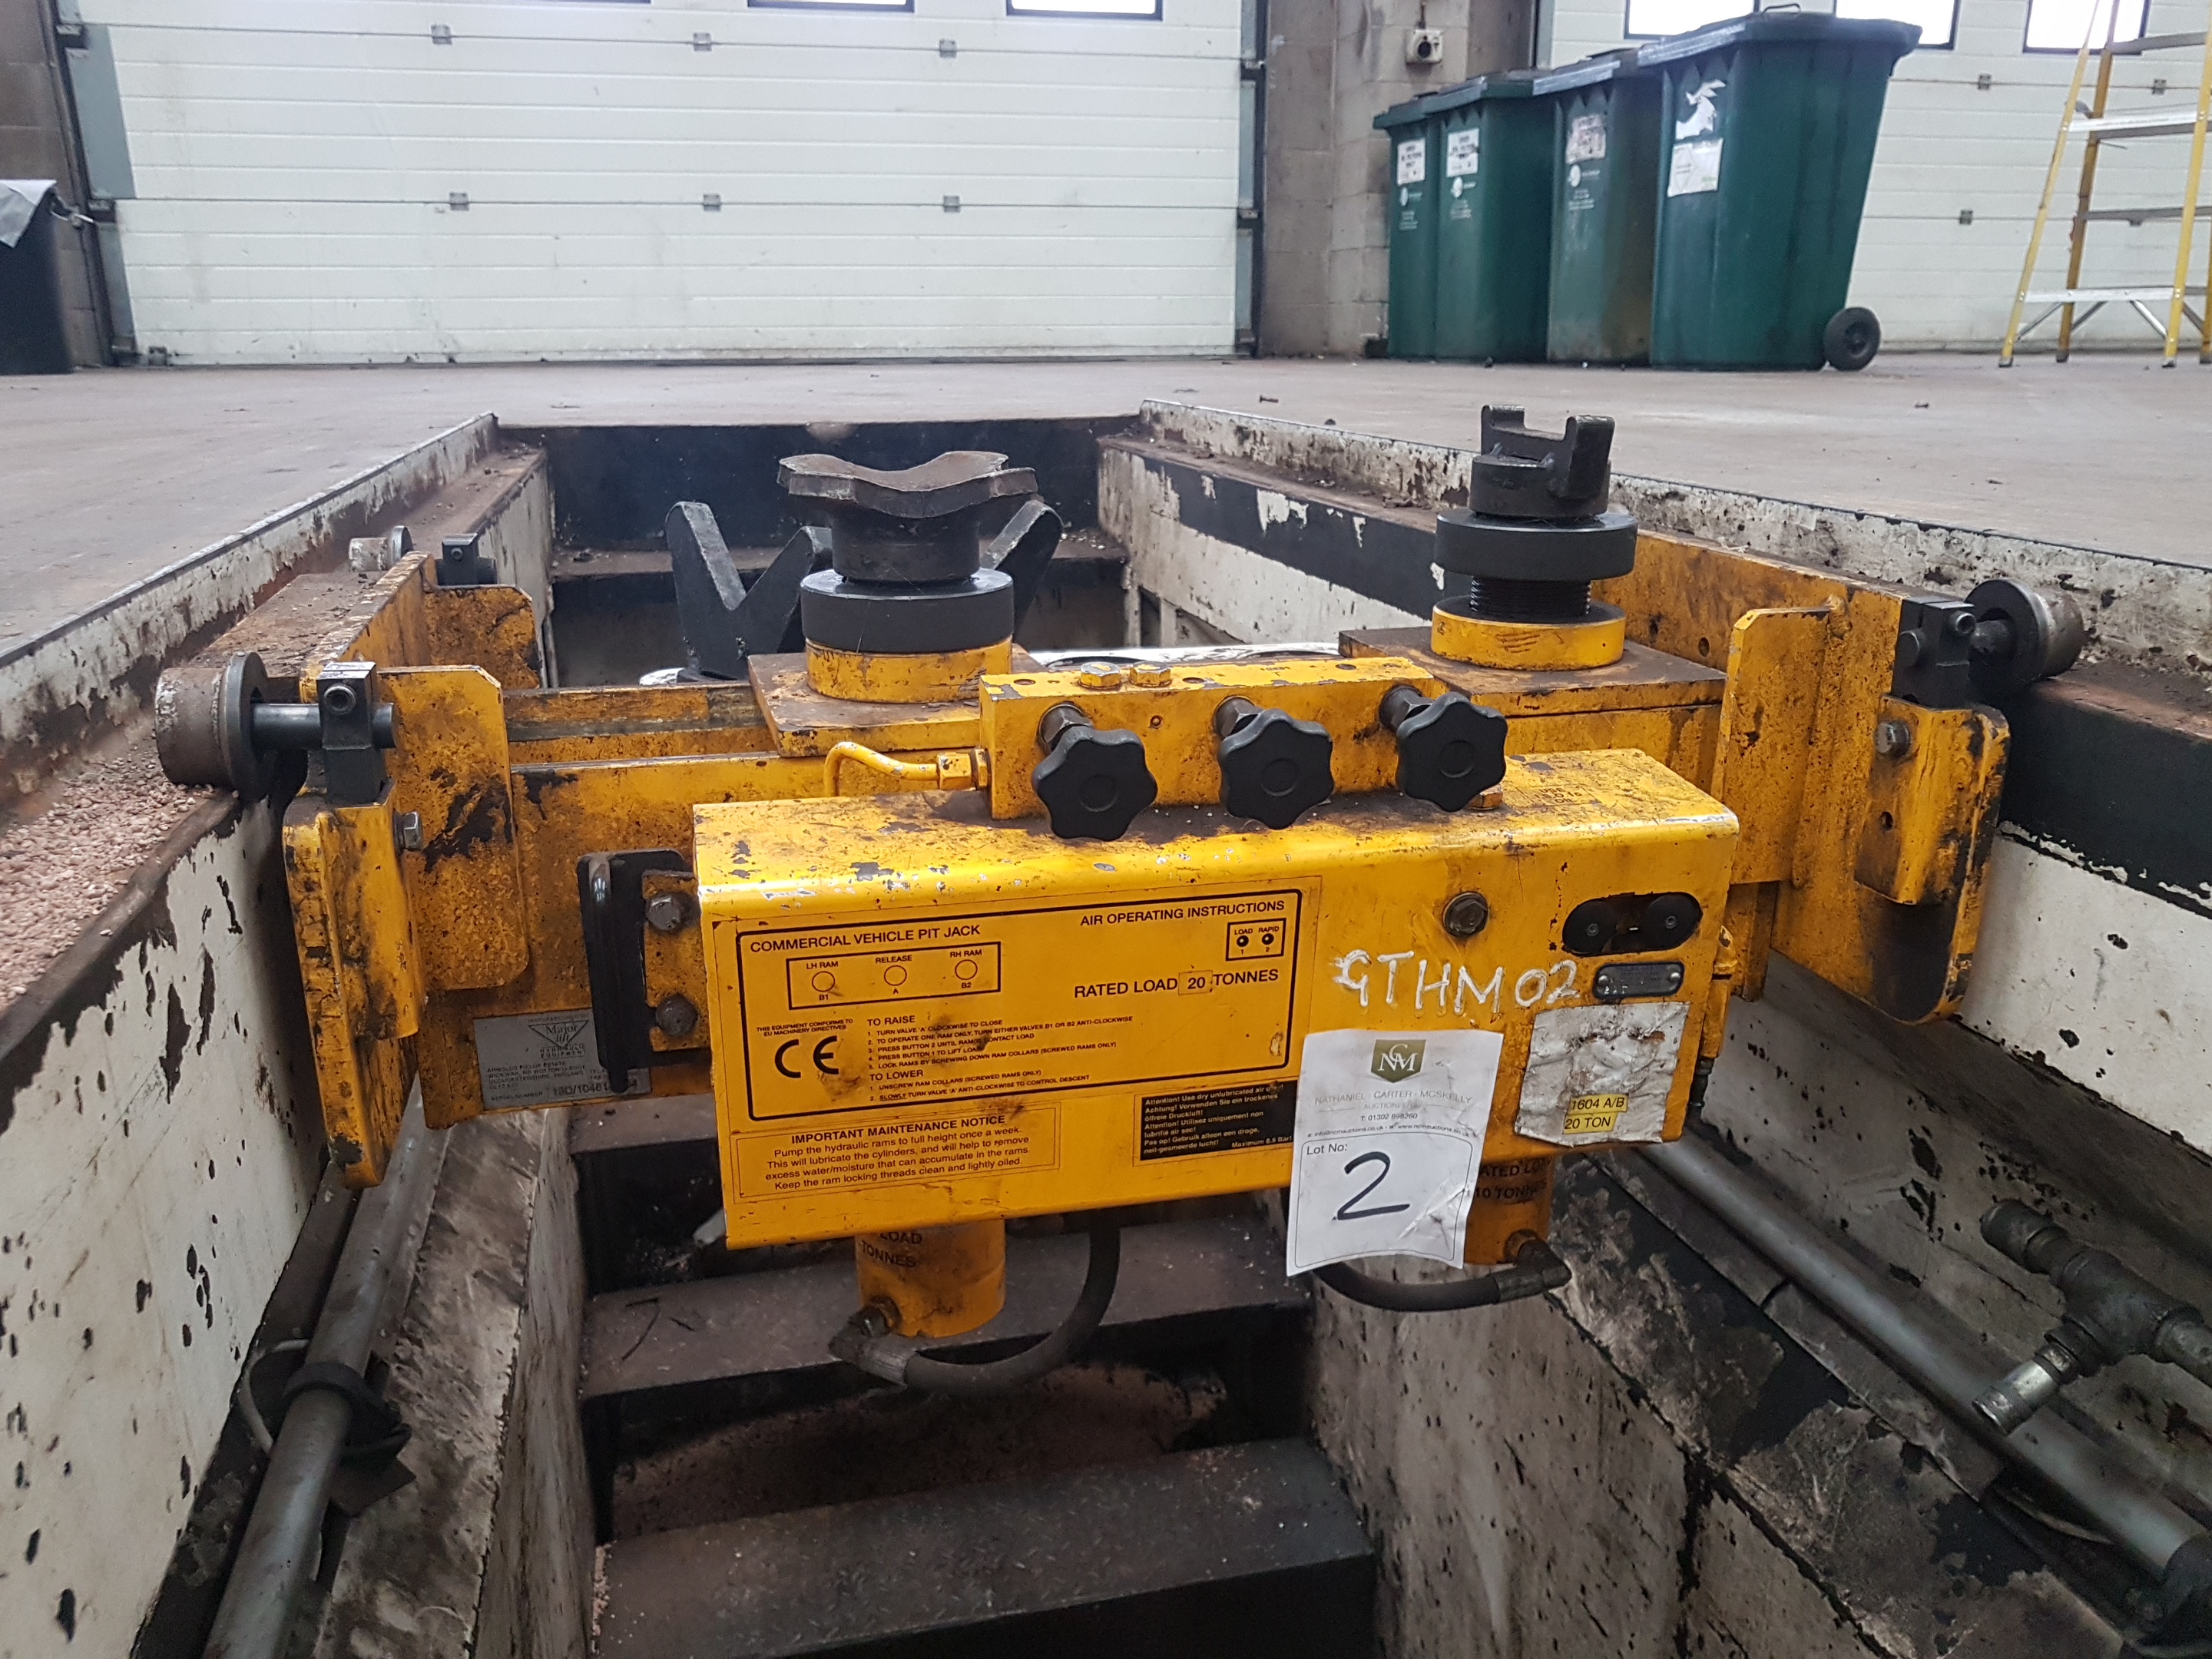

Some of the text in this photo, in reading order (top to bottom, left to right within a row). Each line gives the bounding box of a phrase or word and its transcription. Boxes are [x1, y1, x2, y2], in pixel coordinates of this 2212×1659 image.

[1080, 901, 1284, 926] AIR OPERATING INSTRUCTIONS
[750, 926, 979, 952] COMMERCIAL VEHICLE PIT JACK
[876, 955, 912, 964] RELEASE
[1075, 969, 1279, 998] RATED LOAD 20 TONNES
[868, 1015, 915, 1026] TO RAISE
[775, 1035, 839, 1078] CE
[886, 1070, 923, 1080] LOWER
[1315, 1090, 1473, 1104] NATHANIEL CARTER MCSKELLY
[1571, 1098, 1624, 1110] 1604 A/B
[792, 1115, 1005, 1144] IMPORTANT MAINTENANCE NOTICE
[1565, 1116, 1611, 1129] 20 TON
[768, 1160, 787, 1169] This
[790, 1158, 806, 1167] will
[809, 1154, 851, 1165] lubricate
[853, 1151, 869, 1161] the
[920, 1144, 939, 1154] and
[942, 1143, 956, 1152] will
[959, 1141, 979, 1152] help
[982, 1139, 991, 1147] to
[994, 1137, 1028, 1147] remove
[774, 1147, 803, 1160] Pump
[806, 1145, 821, 1154] the
[824, 1141, 869, 1154] hydraulic
[871, 1140, 896, 1148] rams
[898, 1137, 908, 1145] to
[910, 1135, 925, 1144] full
[927, 1132, 957, 1144] height
[959, 1131, 982, 1139] once
[994, 1125, 1021, 1136] week.
[1306, 1143, 1348, 1155] Lot No:
[765, 1171, 800, 1181] excess
[803, 1161, 874, 1177] water/moisture
[876, 1160, 896, 1169] that
[919, 1151, 973, 1164] accumulate
[976, 1151, 984, 1159] in
[987, 1149, 1002, 1157] the
[774, 1180, 800, 1192] Keep
[803, 1178, 818, 1187] the
[843, 1172, 877, 1185] locking
[879, 1168, 916, 1179] threads
[919, 1165, 945, 1175] clean
[947, 1163, 965, 1172] and
[968, 1160, 995, 1172] lightly
[1336, 1151, 1410, 1220] 2
[860, 1240, 918, 1267] TONNES
